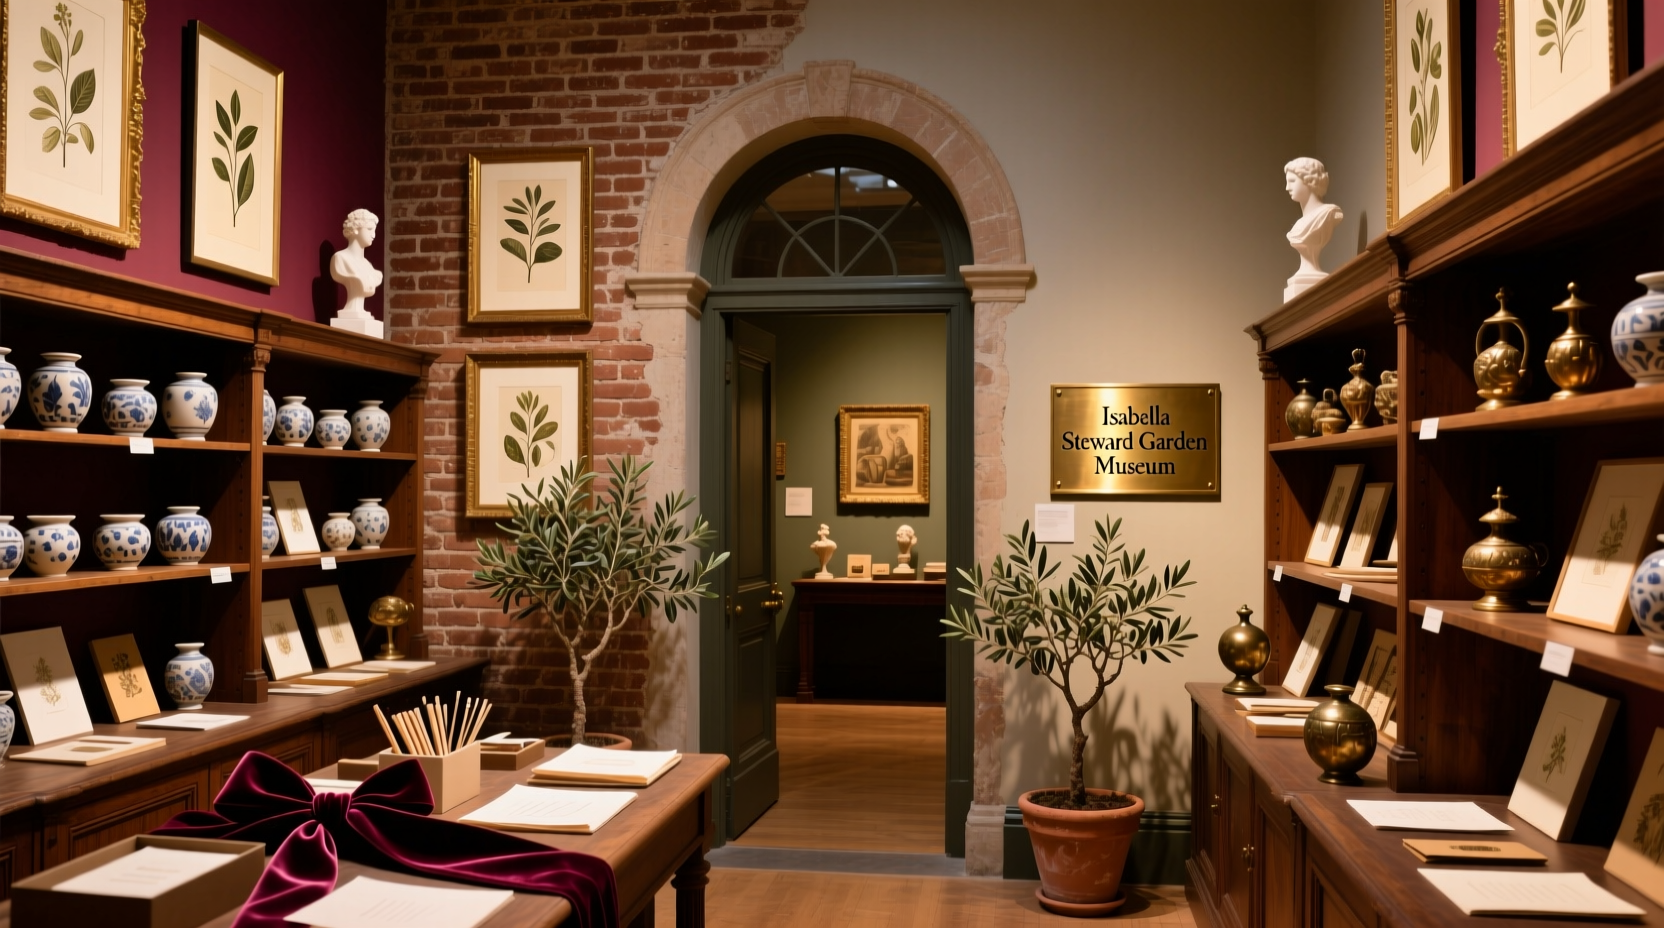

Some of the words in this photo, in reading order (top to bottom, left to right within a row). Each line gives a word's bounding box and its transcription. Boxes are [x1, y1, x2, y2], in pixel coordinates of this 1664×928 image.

[1102, 405, 1170, 426] Isabella
[1062, 431, 1133, 451] Steward
[1139, 430, 1208, 451] Garden
[1094, 456, 1175, 475] Museum
